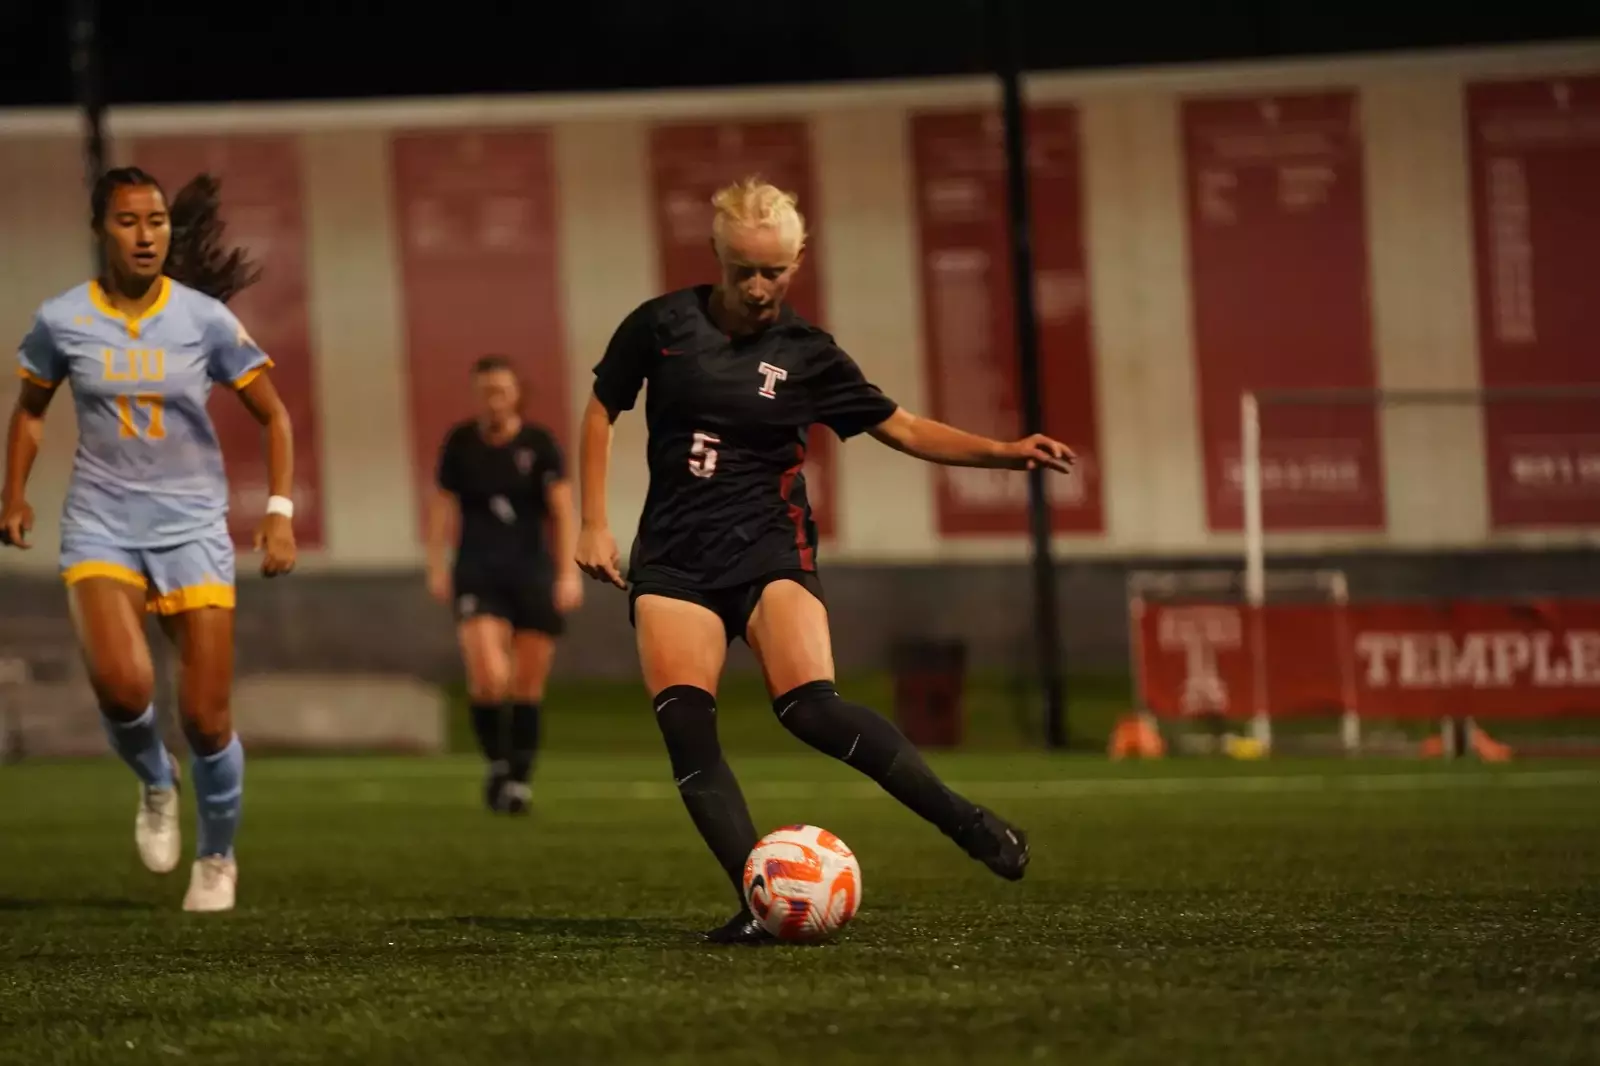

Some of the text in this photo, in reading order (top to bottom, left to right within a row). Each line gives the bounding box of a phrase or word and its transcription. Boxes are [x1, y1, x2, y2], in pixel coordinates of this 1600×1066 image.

[103, 348, 165, 381] LIU
[757, 361, 788, 400] T
[115, 394, 166, 439] 17
[688, 431, 721, 478] 5
[1355, 630, 1600, 688] TEMPLE
